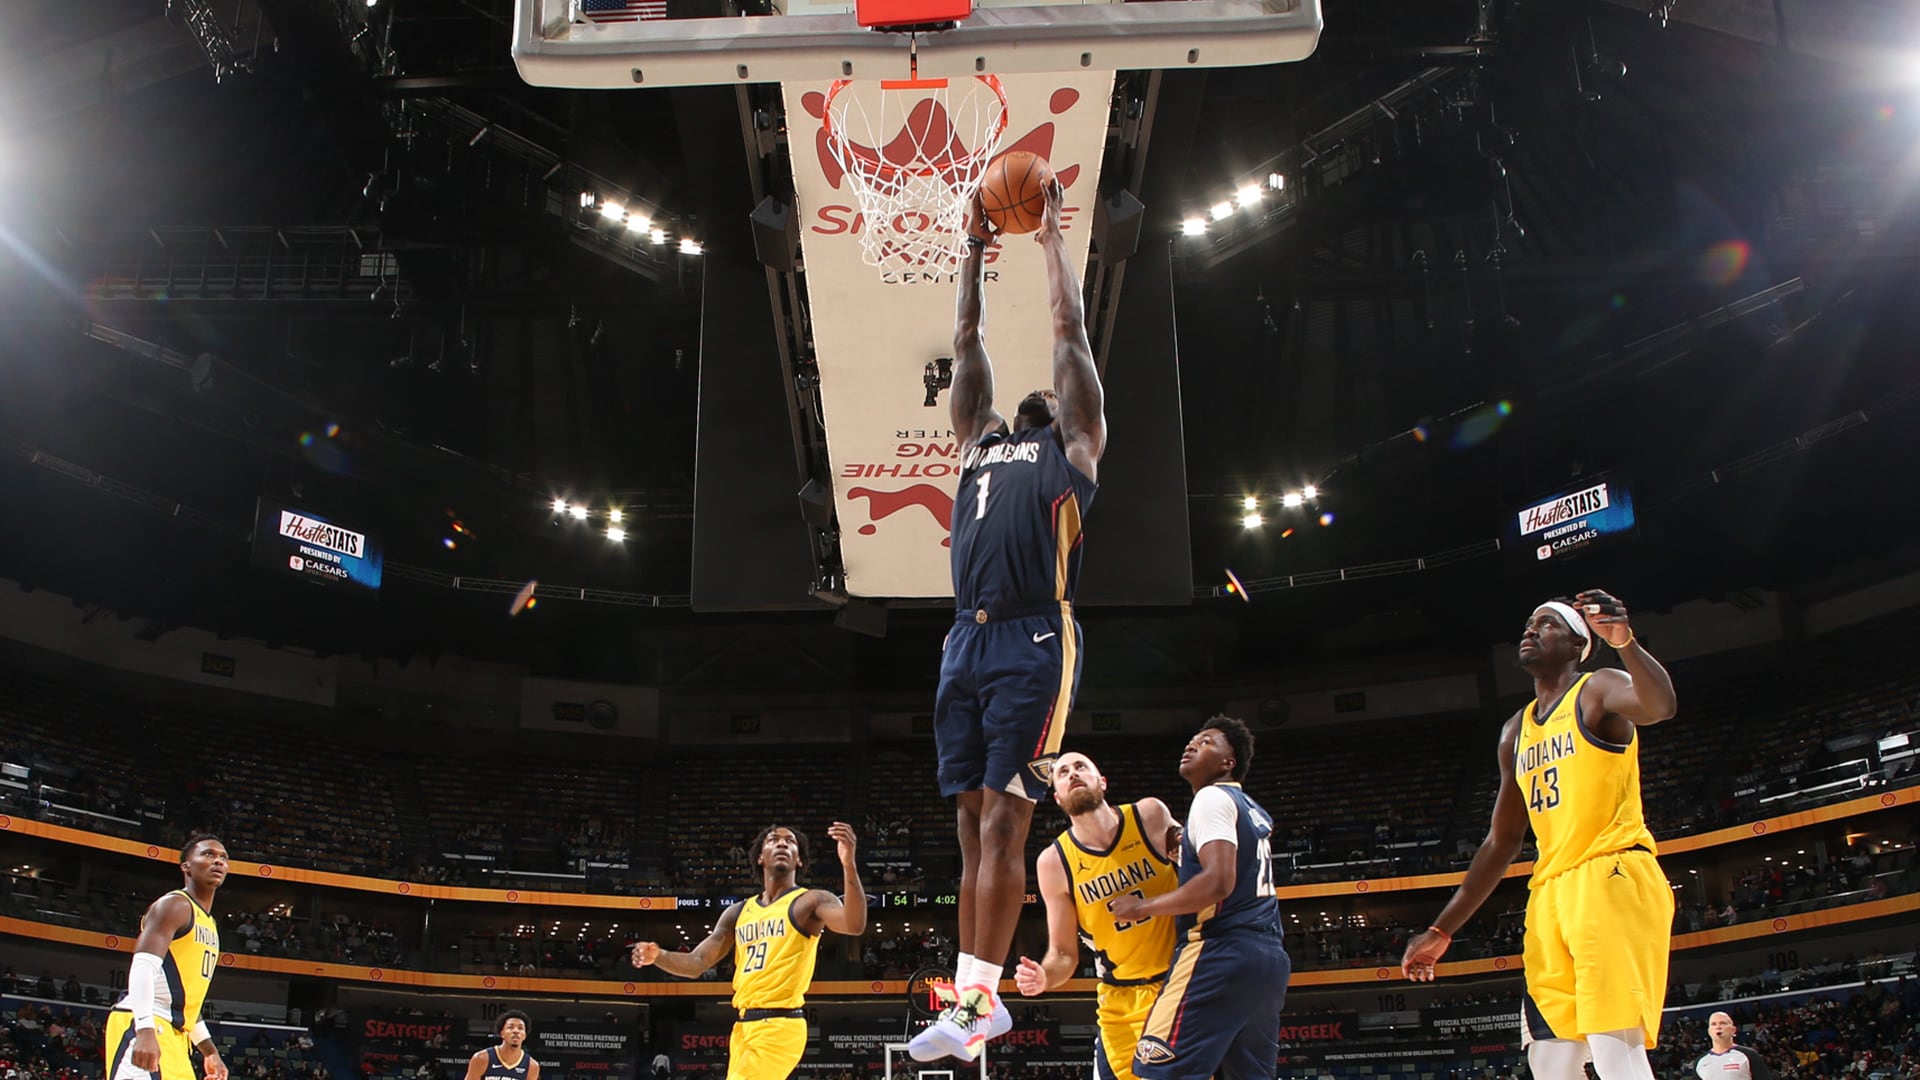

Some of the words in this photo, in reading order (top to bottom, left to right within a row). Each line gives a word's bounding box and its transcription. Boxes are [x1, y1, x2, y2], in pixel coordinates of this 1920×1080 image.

[811, 205, 1080, 235] SMOOE
[882, 271, 1000, 284] CENTR
[896, 430, 956, 438] NTER
[841, 463, 960, 477] OTHIE
[974, 471, 992, 520] 1
[1543, 523, 1578, 540] PRESENTED
[1578, 520, 1587, 529] BY
[1552, 529, 1598, 550] CAESARS
[300, 545, 333, 562] PRESENTED
[333, 555, 341, 564] BY
[305, 560, 348, 578] CAESARS
[1530, 767, 1560, 813] 43
[1079, 858, 1157, 905] INDIANA
[678, 899, 700, 907] FOULS
[704, 899, 711, 907] 2
[894, 895, 908, 906] 54
[935, 895, 957, 905] 4:02
[743, 941, 767, 973] 29
[1378, 994, 1405, 1012] 108
[1433, 1019, 1460, 1027] OFFICIAL
[1460, 1017, 1491, 1026] TICKETING
[1492, 1014, 1520, 1022] PARTNER
[540, 1033, 564, 1041] OFFICIAL
[565, 1034, 593, 1042] TICKETING
[986, 1029, 1050, 1047] TGEEK
[1280, 1022, 1344, 1041] ATGEEK
[682, 1034, 728, 1050] SEATG
